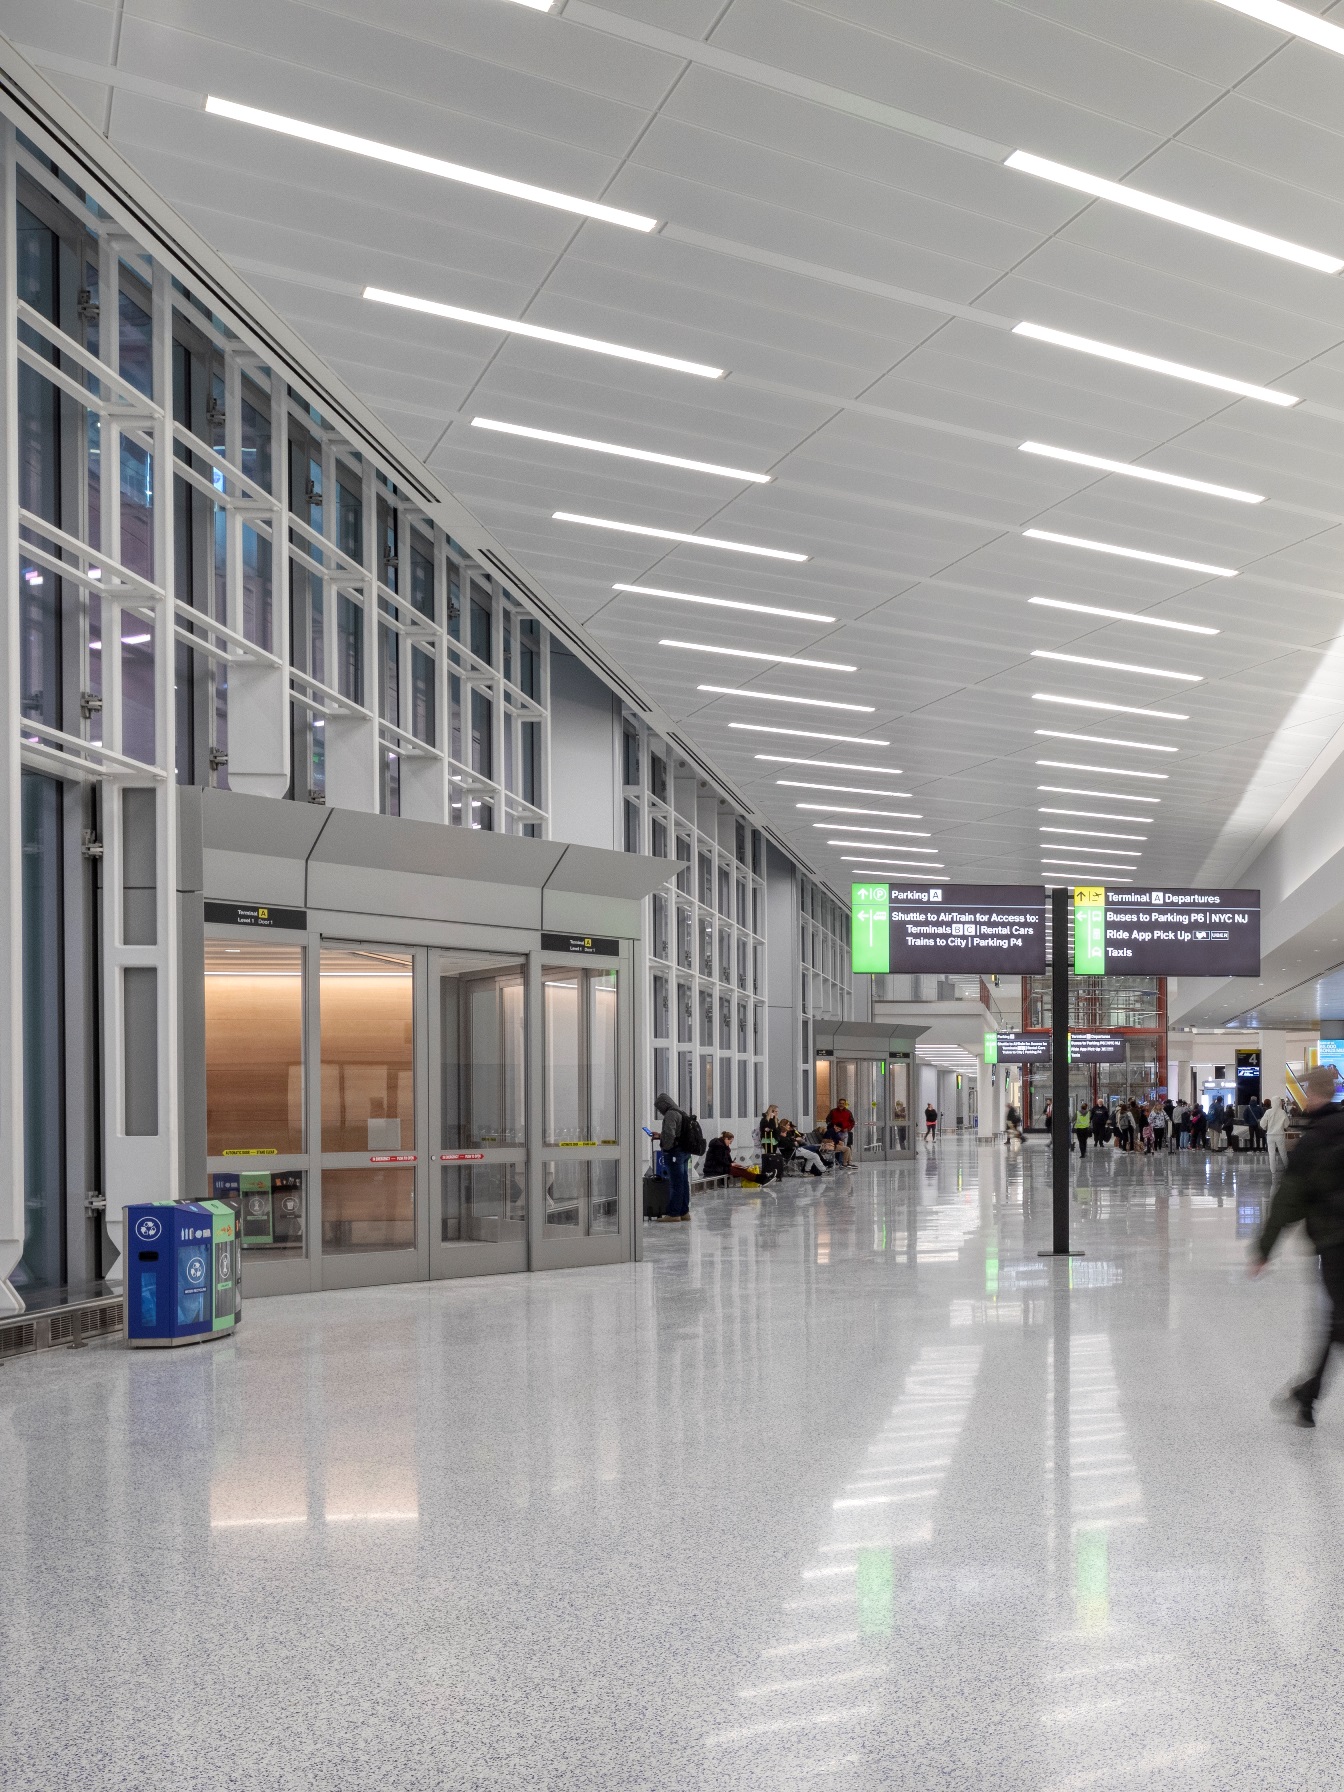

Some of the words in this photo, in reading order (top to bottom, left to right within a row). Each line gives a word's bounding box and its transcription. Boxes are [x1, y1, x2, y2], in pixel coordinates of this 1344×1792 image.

[891, 890, 928, 901] Parking
[1107, 893, 1150, 902] Terminal
[1165, 894, 1220, 904] Departures
[891, 911, 926, 921] Shuttle
[927, 913, 937, 921] to
[939, 912, 974, 922] AirTrain
[976, 913, 989, 922] for
[991, 913, 1025, 922] Access
[1026, 914, 1039, 923] to:
[1106, 912, 1137, 921] Buses
[1139, 913, 1150, 921] to
[1151, 912, 1188, 924] Parking
[1191, 913, 1204, 922] P6
[1211, 914, 1232, 923] NYC
[1234, 914, 1248, 923] NJ
[906, 925, 951, 934] Terminals
[981, 925, 1010, 935] Rental
[1012, 926, 1034, 935] Cars
[1106, 930, 1129, 939] Ride
[1131, 930, 1151, 941] App
[1154, 930, 1175, 939] Pick
[1177, 931, 1191, 941] Up
[906, 937, 934, 946] Trains
[936, 938, 946, 946] to
[947, 937, 966, 948] City
[973, 938, 1008, 948] Parking
[1010, 938, 1022, 947] P4
[1106, 948, 1133, 957] Taxis
[1248, 1054, 1258, 1065] 4
